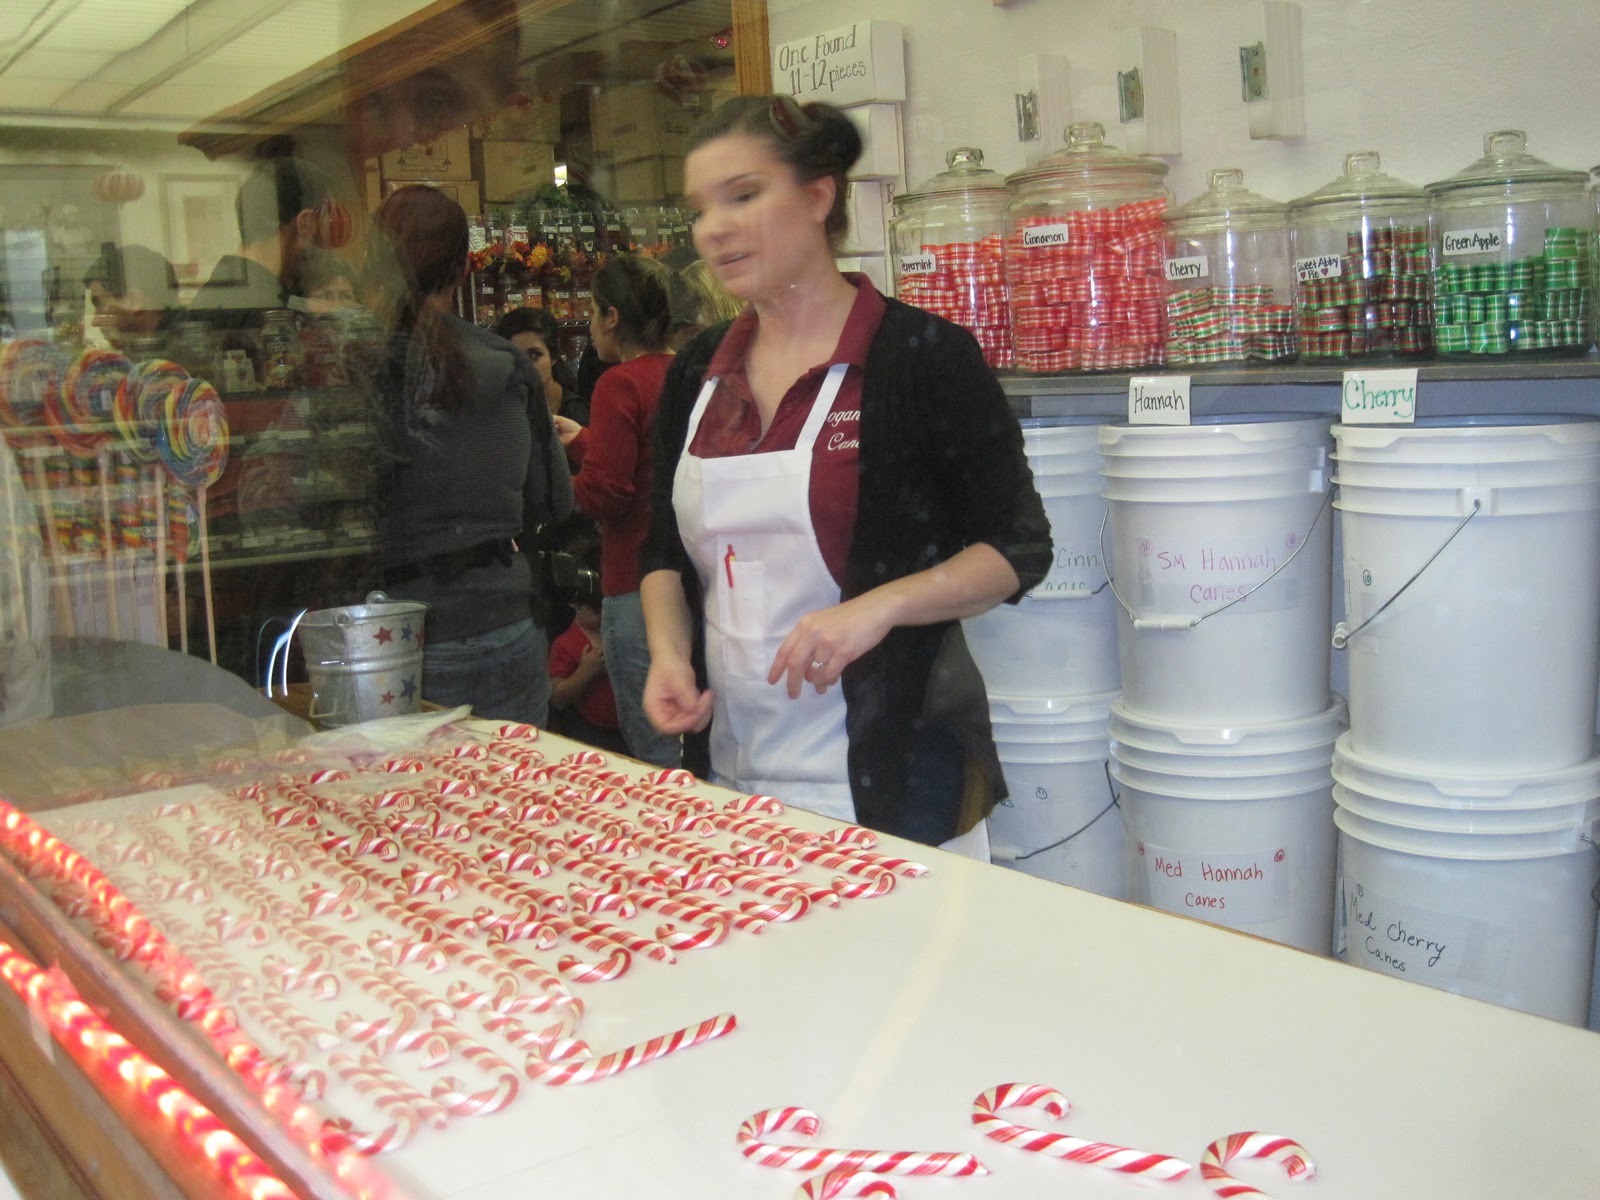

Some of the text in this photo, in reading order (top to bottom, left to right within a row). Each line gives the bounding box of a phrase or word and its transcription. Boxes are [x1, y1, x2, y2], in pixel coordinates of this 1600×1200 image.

[779, 24, 857, 71] One Pound
[789, 59, 866, 97] 11-12 pieces
[1024, 231, 1065, 245] Cinnamon
[1445, 233, 1499, 251] Green Apple
[1169, 261, 1202, 278] Cherry
[1297, 256, 1339, 272] Sweet Abby
[1308, 270, 1320, 279] Pie
[1134, 386, 1185, 414] Hannah
[1344, 377, 1414, 418] Cherry
[826, 410, 861, 428] ogan
[1201, 547, 1276, 571] Hannah
[1155, 857, 1263, 882] Med Hannah
[1184, 892, 1225, 909] Canes
[1350, 891, 1446, 967] Med Cherry
[1365, 936, 1406, 972] Canes
